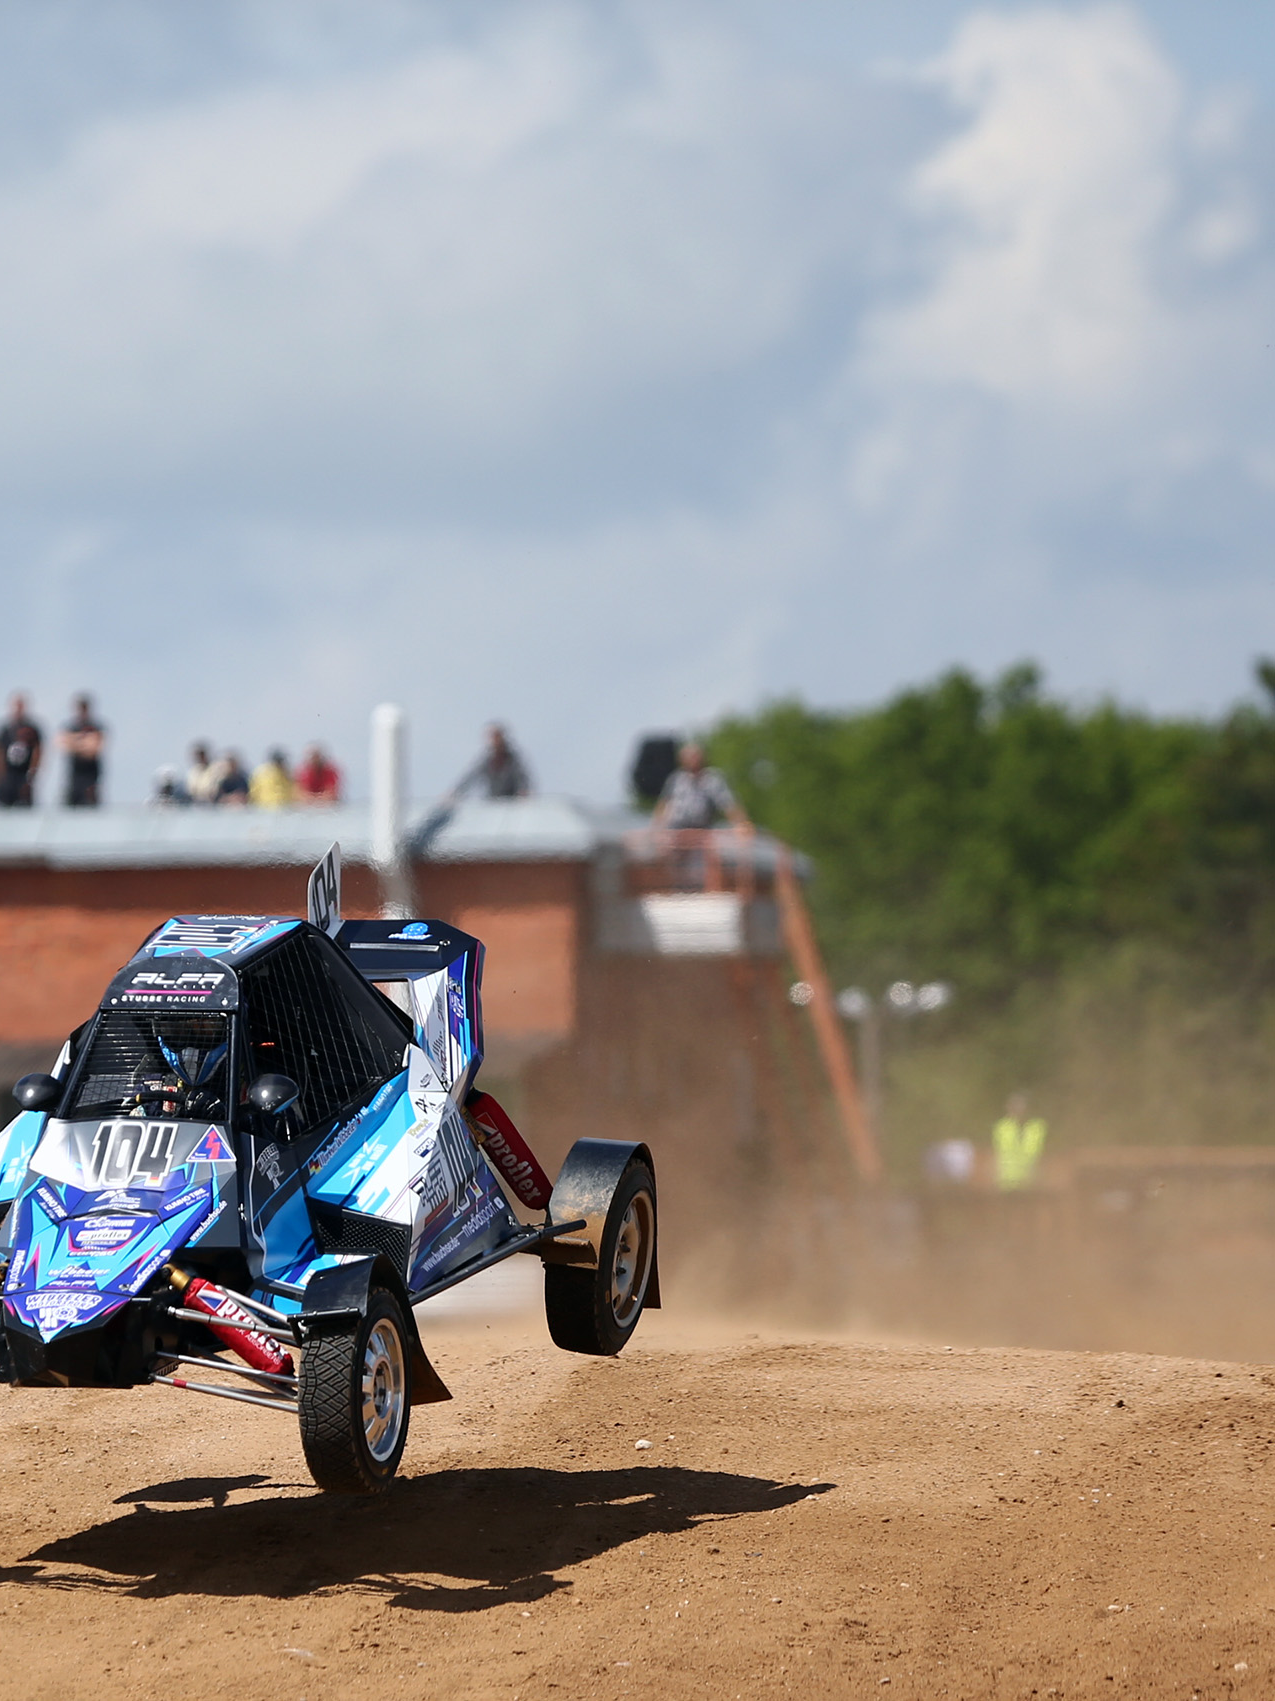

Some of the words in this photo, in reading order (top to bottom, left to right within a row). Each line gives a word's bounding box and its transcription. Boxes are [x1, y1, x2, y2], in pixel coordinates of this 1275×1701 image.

[121, 995, 162, 1003] STUBBE
[166, 995, 206, 1003] RACING
[131, 972, 225, 985] ALFA
[91, 1121, 178, 1187] 104
[485, 1132, 541, 1200] proflex
[189, 1200, 228, 1242] www.buchse.de
